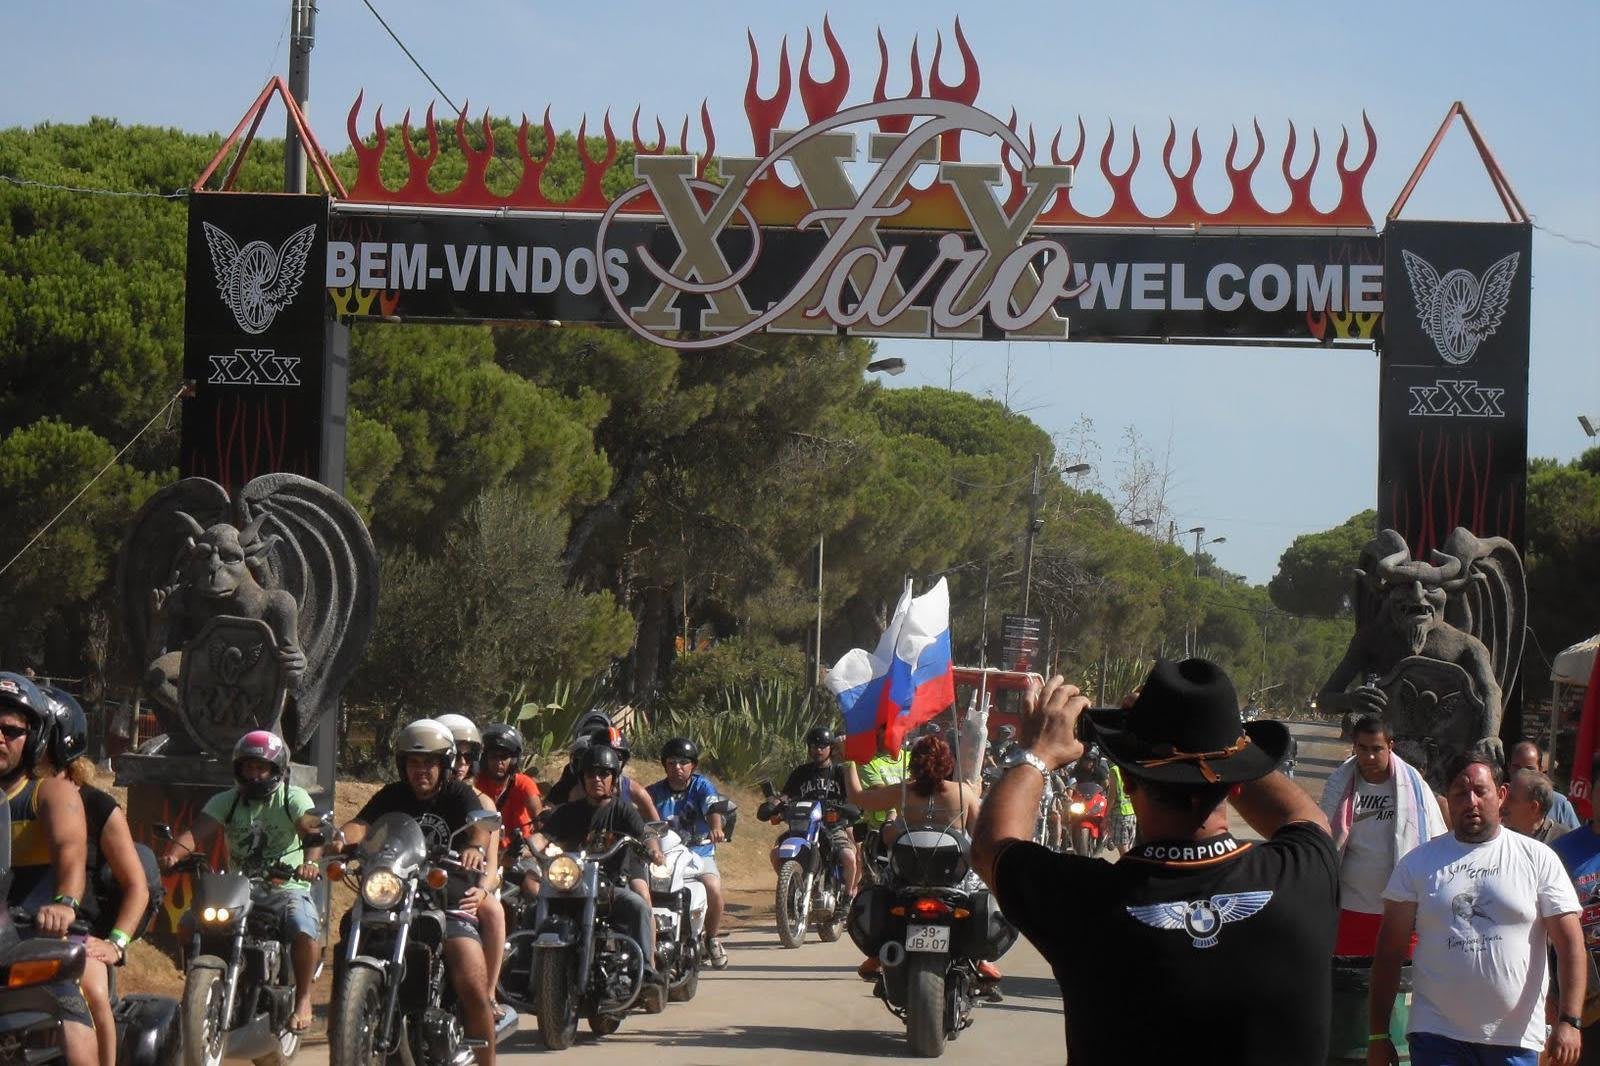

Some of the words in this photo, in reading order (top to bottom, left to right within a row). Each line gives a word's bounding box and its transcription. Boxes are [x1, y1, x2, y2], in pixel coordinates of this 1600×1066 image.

[598, 97, 1091, 348] Faro
[326, 241, 629, 296] BEM-VINDOS
[1073, 262, 1384, 313] WELCOME
[1356, 795, 1391, 809] NIKE
[1376, 810, 1395, 820] AIR
[1143, 838, 1238, 860] SCORPION
[921, 927, 936, 938] 39
[932, 939, 947, 950] 07
